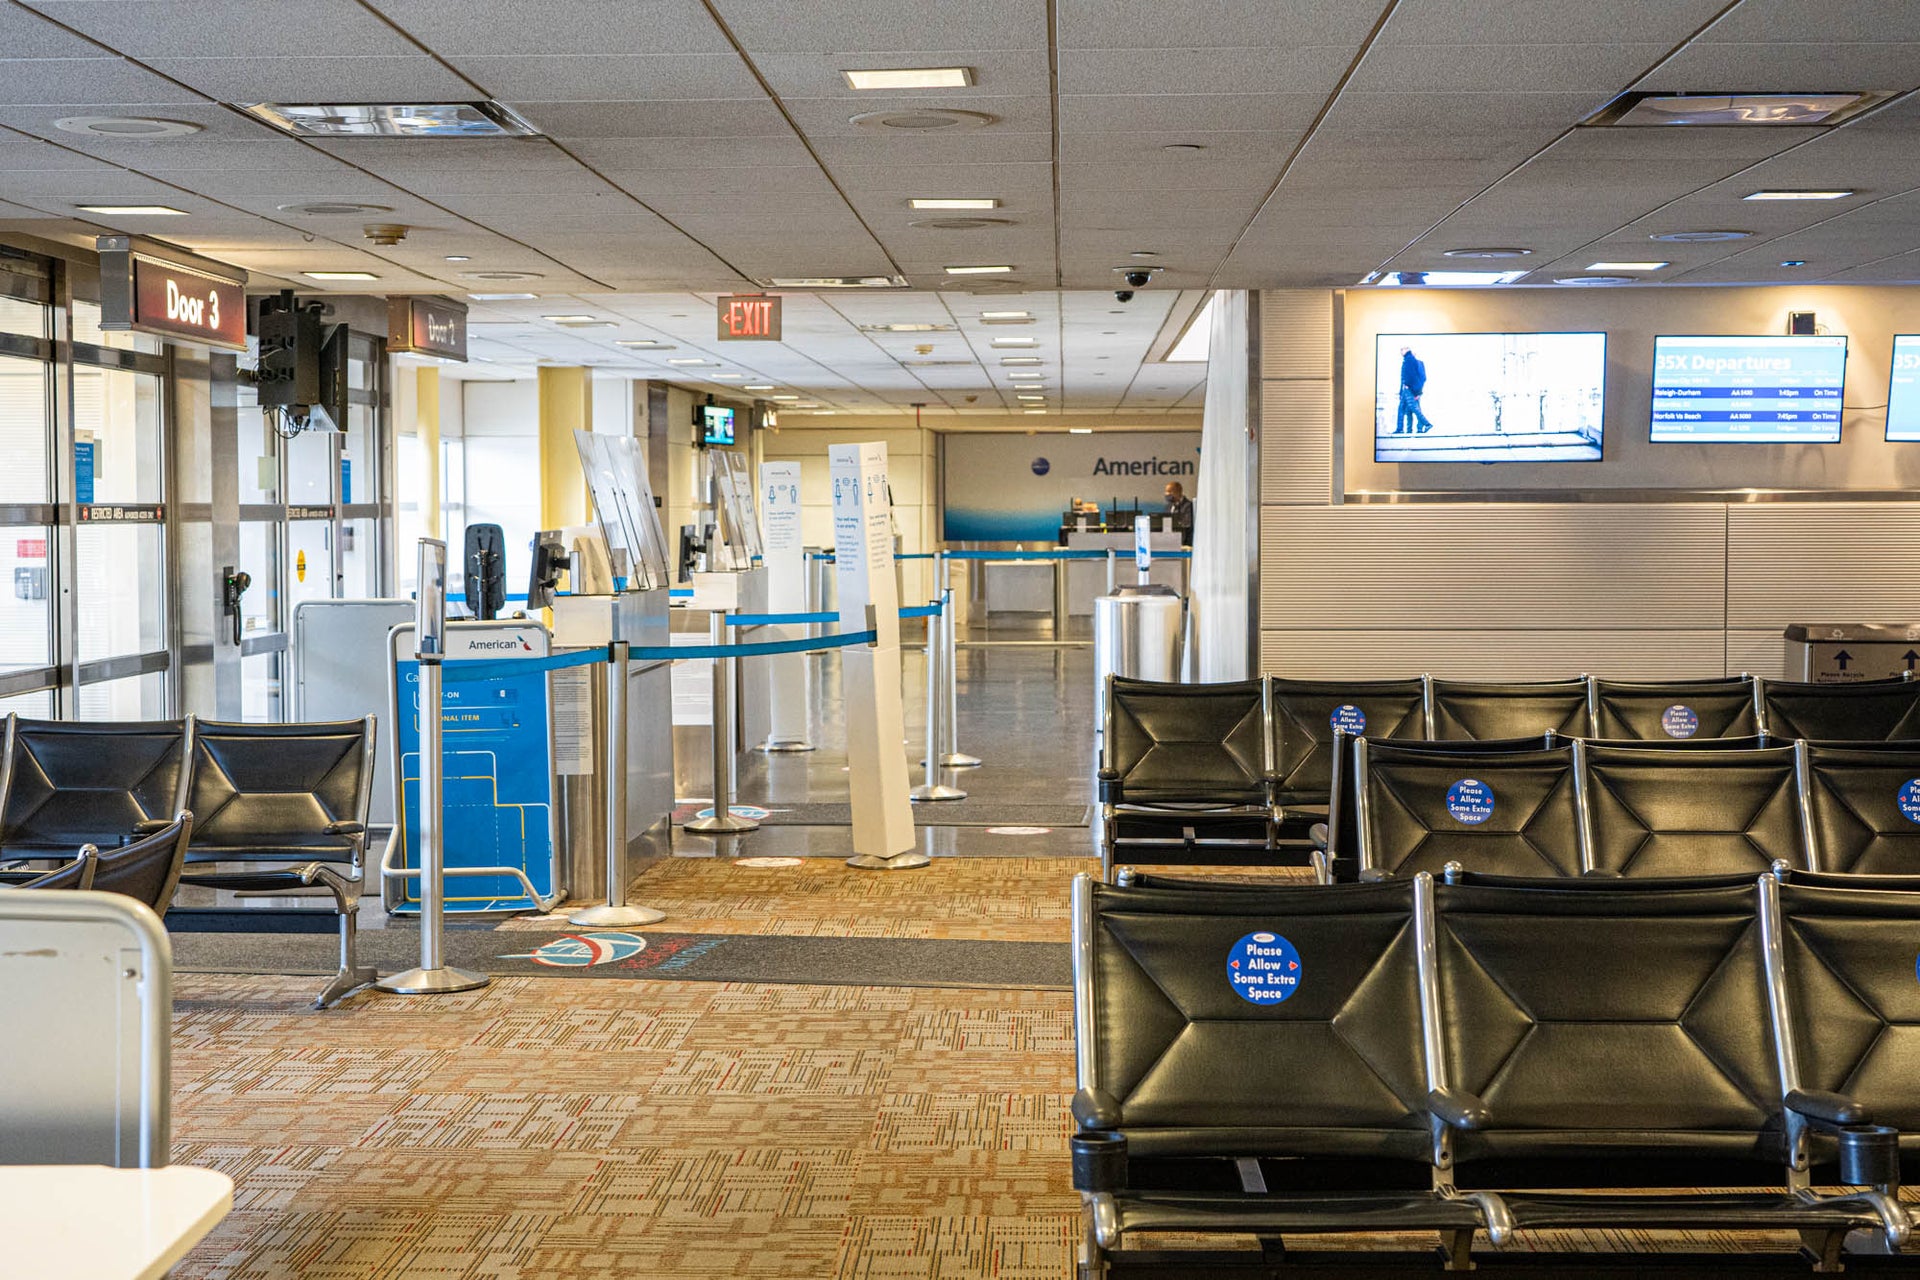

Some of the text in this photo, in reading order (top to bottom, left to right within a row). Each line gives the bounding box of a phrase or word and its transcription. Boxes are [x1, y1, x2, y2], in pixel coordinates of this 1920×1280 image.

[166, 279, 220, 329] Door 3
[730, 302, 772, 336] EXIT
[428, 313, 447, 344] Door
[1656, 355, 1791, 374] 35X Departures
[1093, 456, 1194, 476] American
[469, 640, 517, 650] American
[406, 673, 419, 683] Ca
[1460, 786, 1482, 795] Please
[1460, 795, 1481, 803] Allow
[1451, 804, 1490, 813] Some Extra
[1460, 813, 1481, 821] Space
[1246, 944, 1282, 956] Please
[1248, 958, 1281, 970] Allow
[1234, 972, 1296, 985] Some Extra
[1248, 986, 1282, 1001] Space
